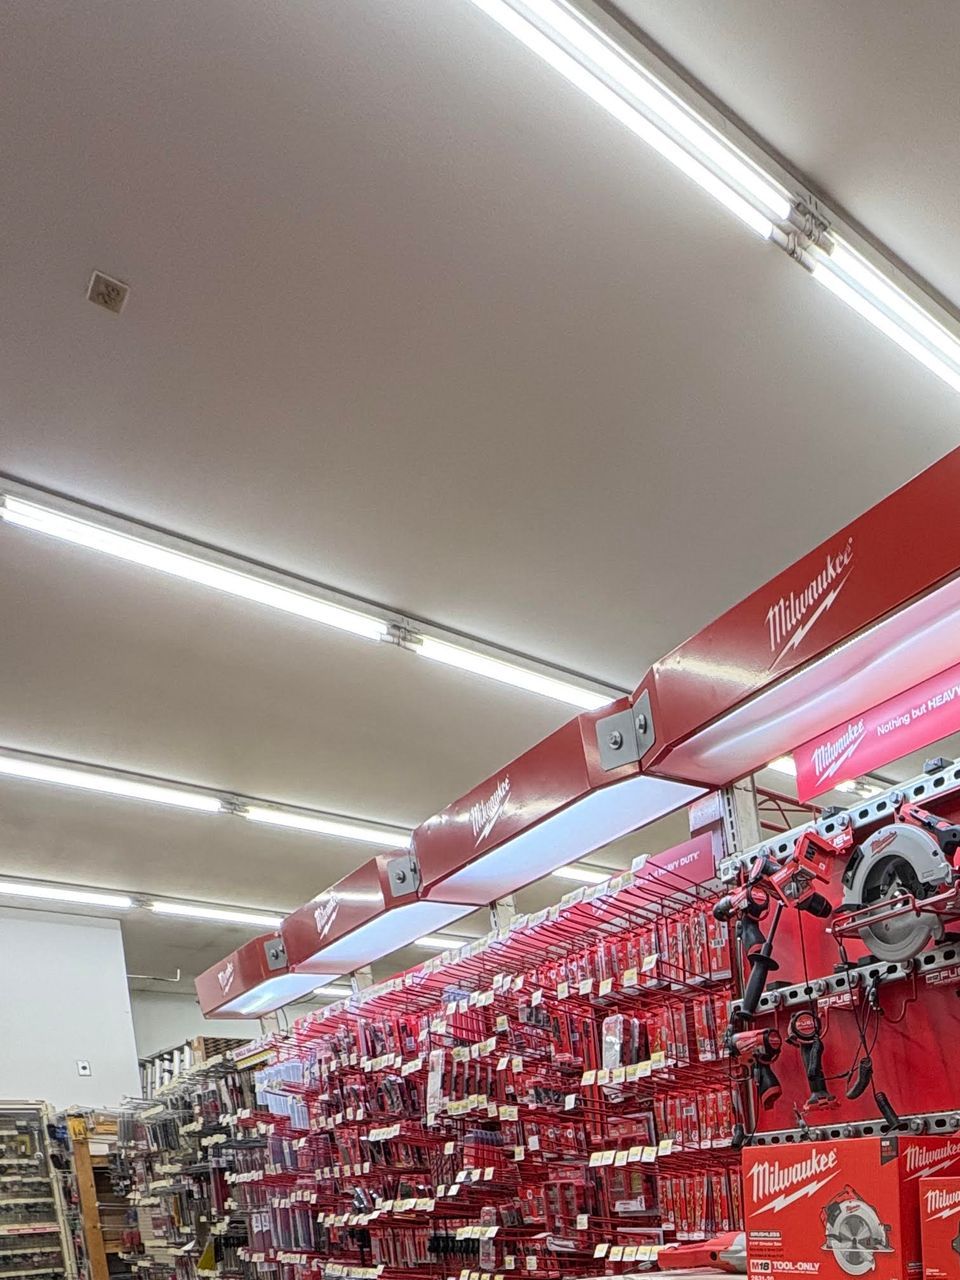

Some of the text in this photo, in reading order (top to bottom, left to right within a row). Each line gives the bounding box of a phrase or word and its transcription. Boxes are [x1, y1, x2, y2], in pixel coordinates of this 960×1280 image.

[765, 545, 853, 652] Milwaukee
[811, 719, 864, 776] Milwaukee
[877, 713, 912, 737] Nothing
[912, 703, 927, 718] but
[747, 1149, 836, 1203] Milwaukee
[751, 1261, 820, 1272] M18 TOOL-ONLY
